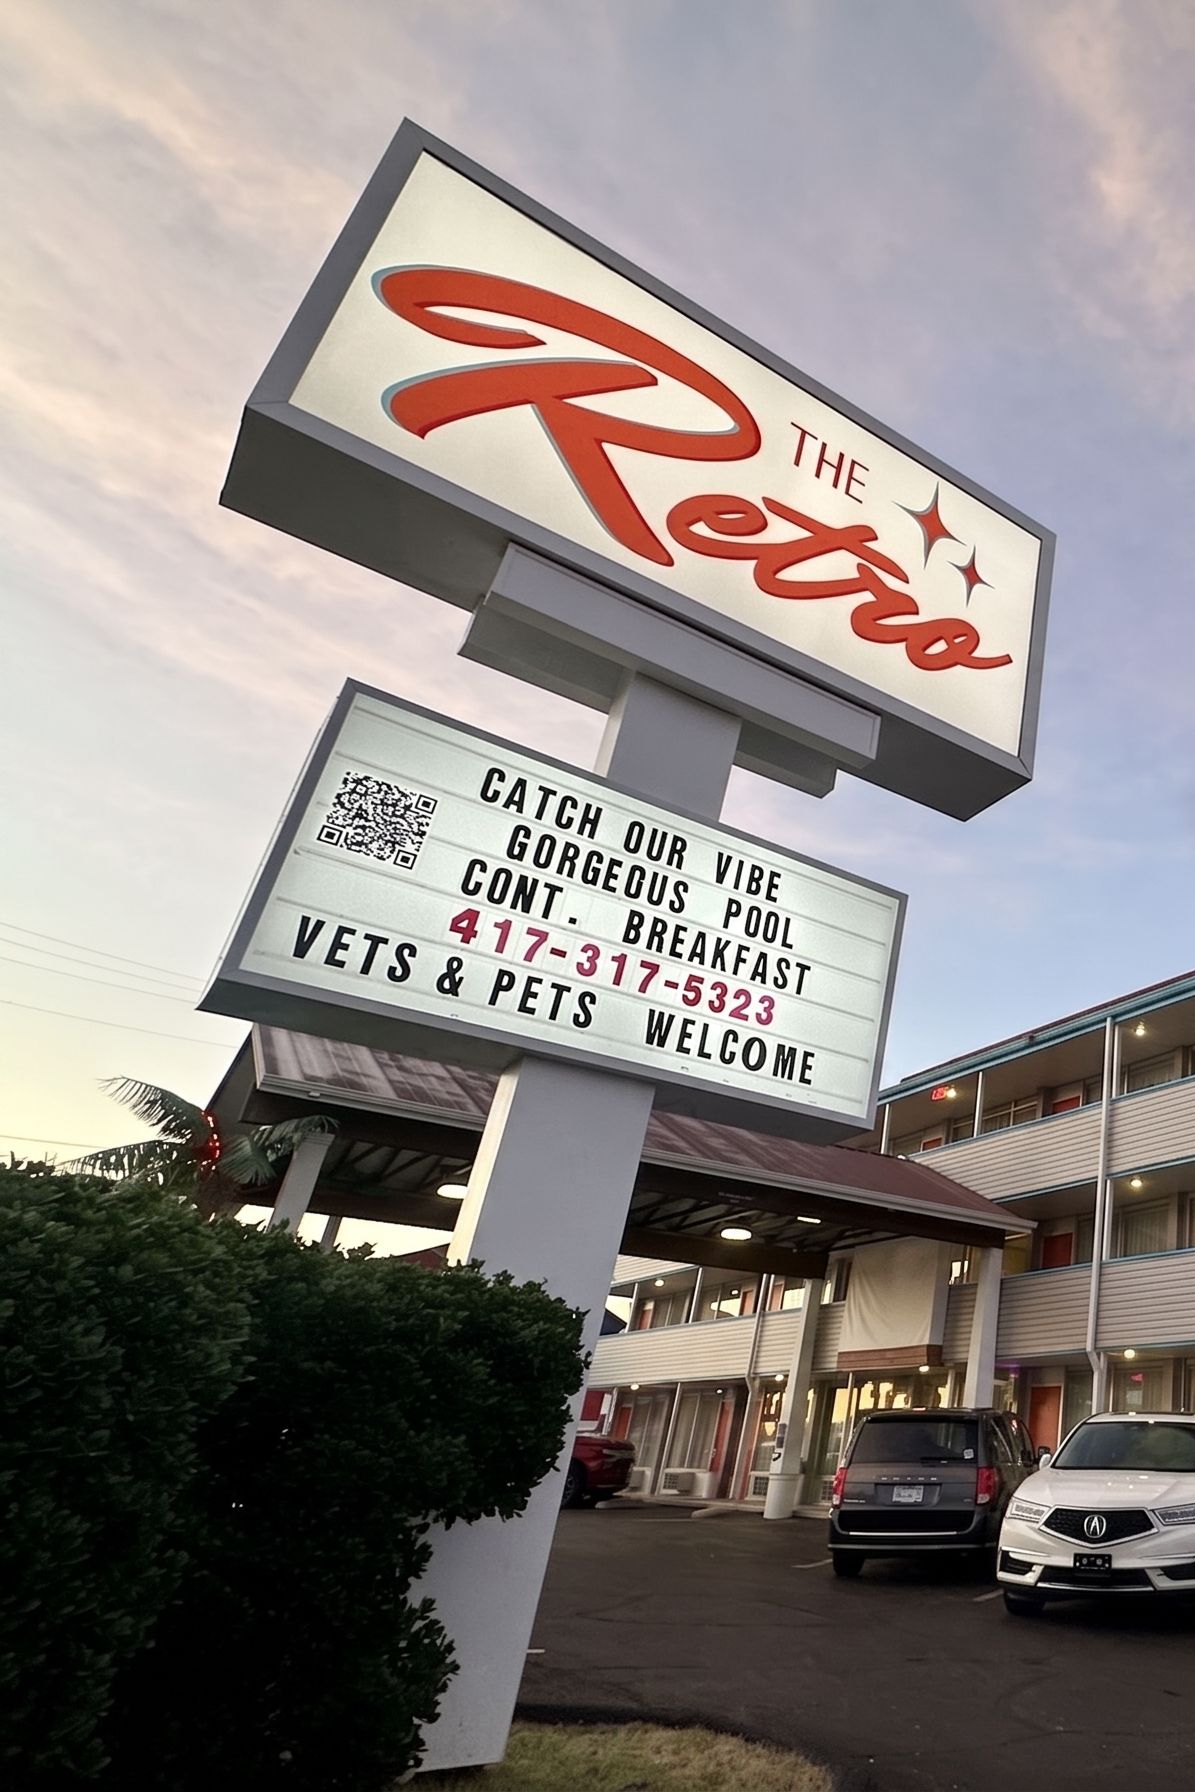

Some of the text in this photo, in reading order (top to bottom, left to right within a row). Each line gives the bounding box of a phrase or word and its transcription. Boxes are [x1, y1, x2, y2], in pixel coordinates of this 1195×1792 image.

[371, 263, 1014, 671] Retro
[789, 421, 871, 505] THE
[479, 767, 782, 904] CATCH OUR VIBE
[506, 824, 794, 950] GORGEOUS POOL
[292, 914, 815, 1086] VETS & PETS WELCOME
[449, 908, 775, 1026] 417-317-5323
[621, 909, 812, 996] BREAKFAST
